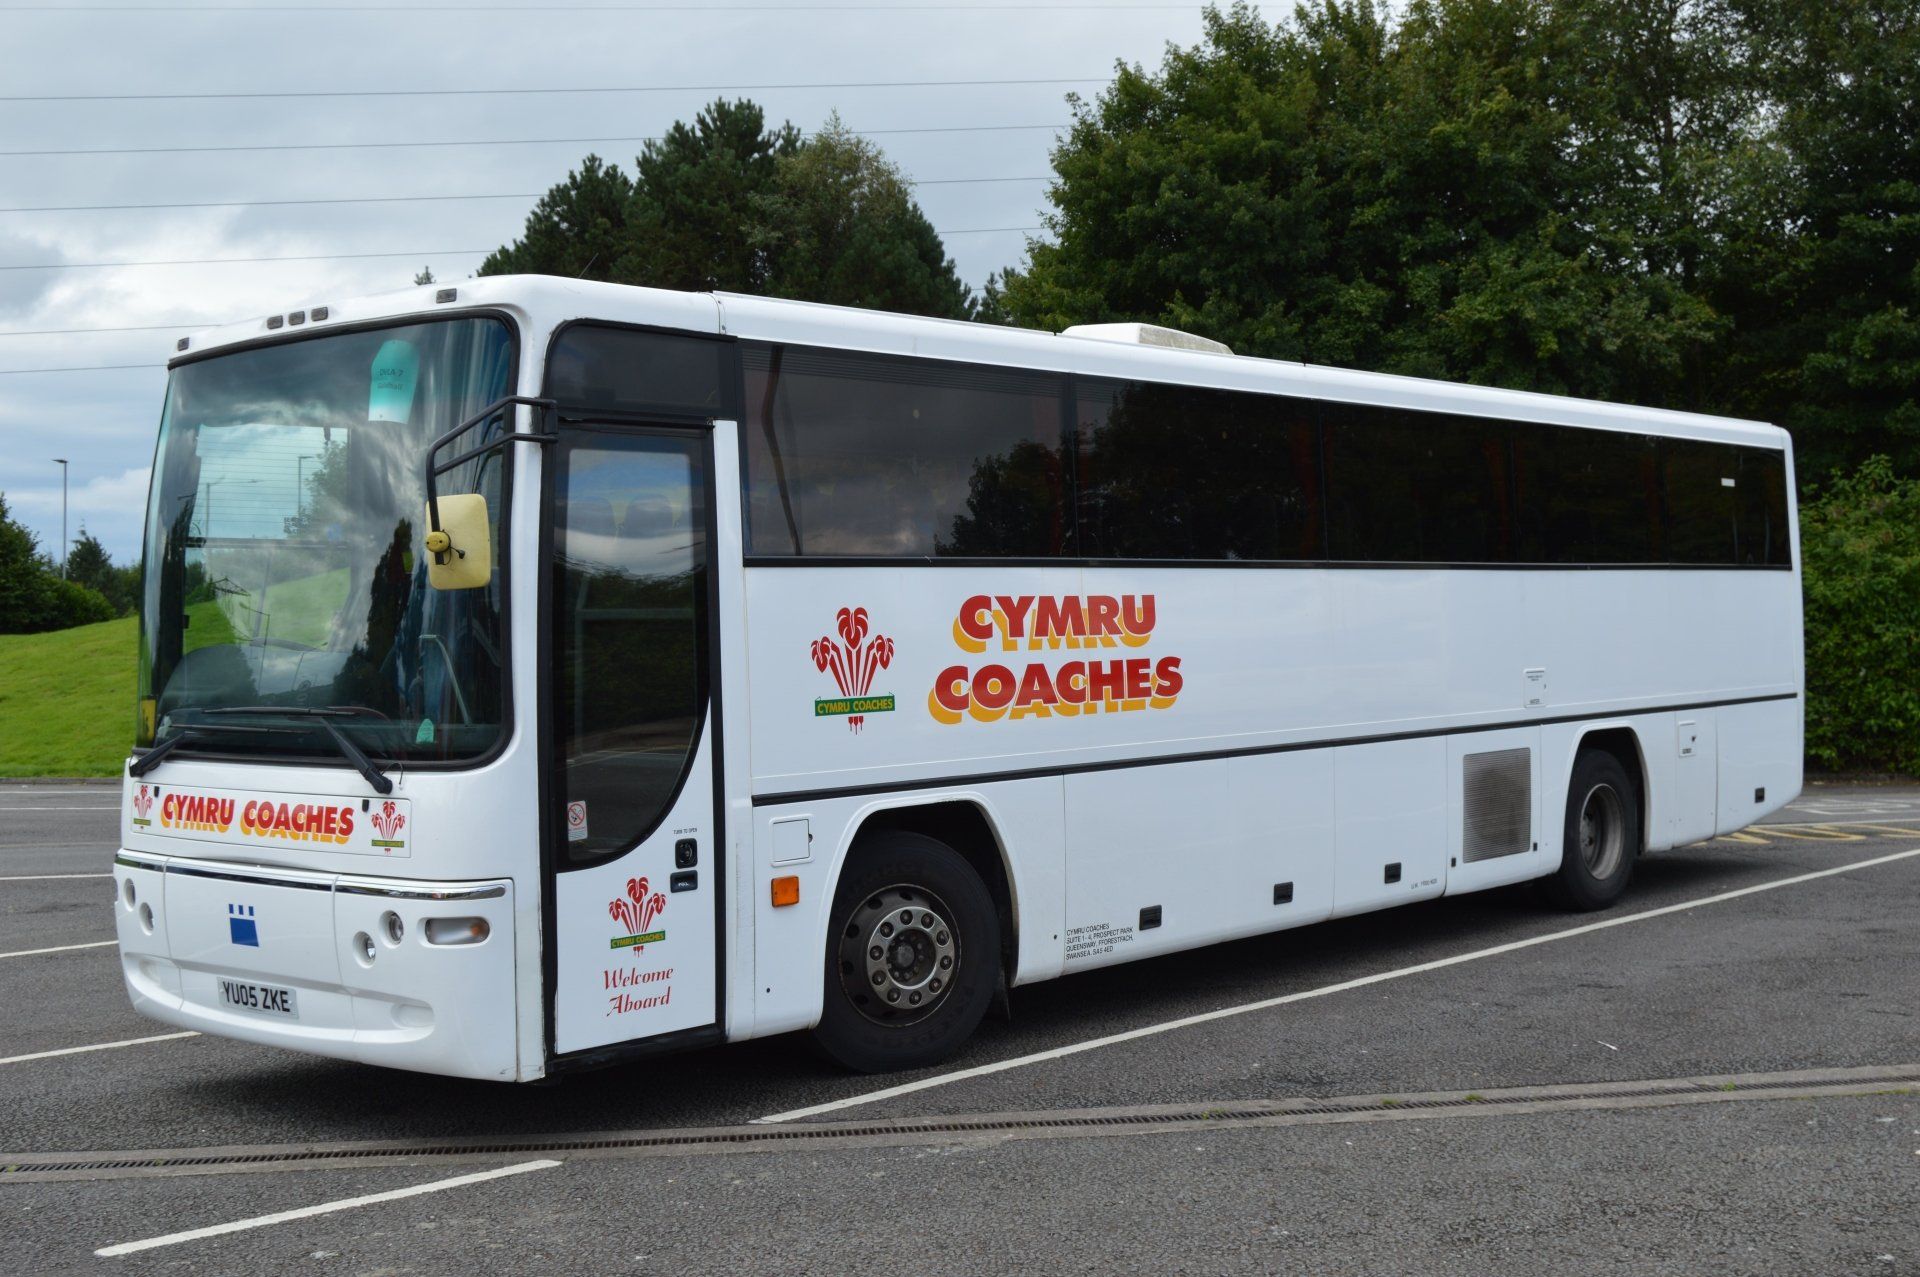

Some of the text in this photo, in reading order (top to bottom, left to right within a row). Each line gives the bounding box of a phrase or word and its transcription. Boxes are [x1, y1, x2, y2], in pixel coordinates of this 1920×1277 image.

[953, 594, 1157, 653] CYMRU
[928, 656, 1183, 725] COACHES
[817, 698, 893, 714] CYMRU COACHES
[160, 794, 354, 844] CYMRU COACHES
[611, 933, 664, 948] CYMRU COACHES
[1066, 936, 1081, 944] SUITE
[1093, 929, 1120, 939] PROSPECT
[1067, 924, 1109, 936] CYMRU COACHES
[604, 967, 674, 990] Welcome
[222, 981, 291, 1012] YU05 ZKE
[606, 986, 671, 1017] Aboard
